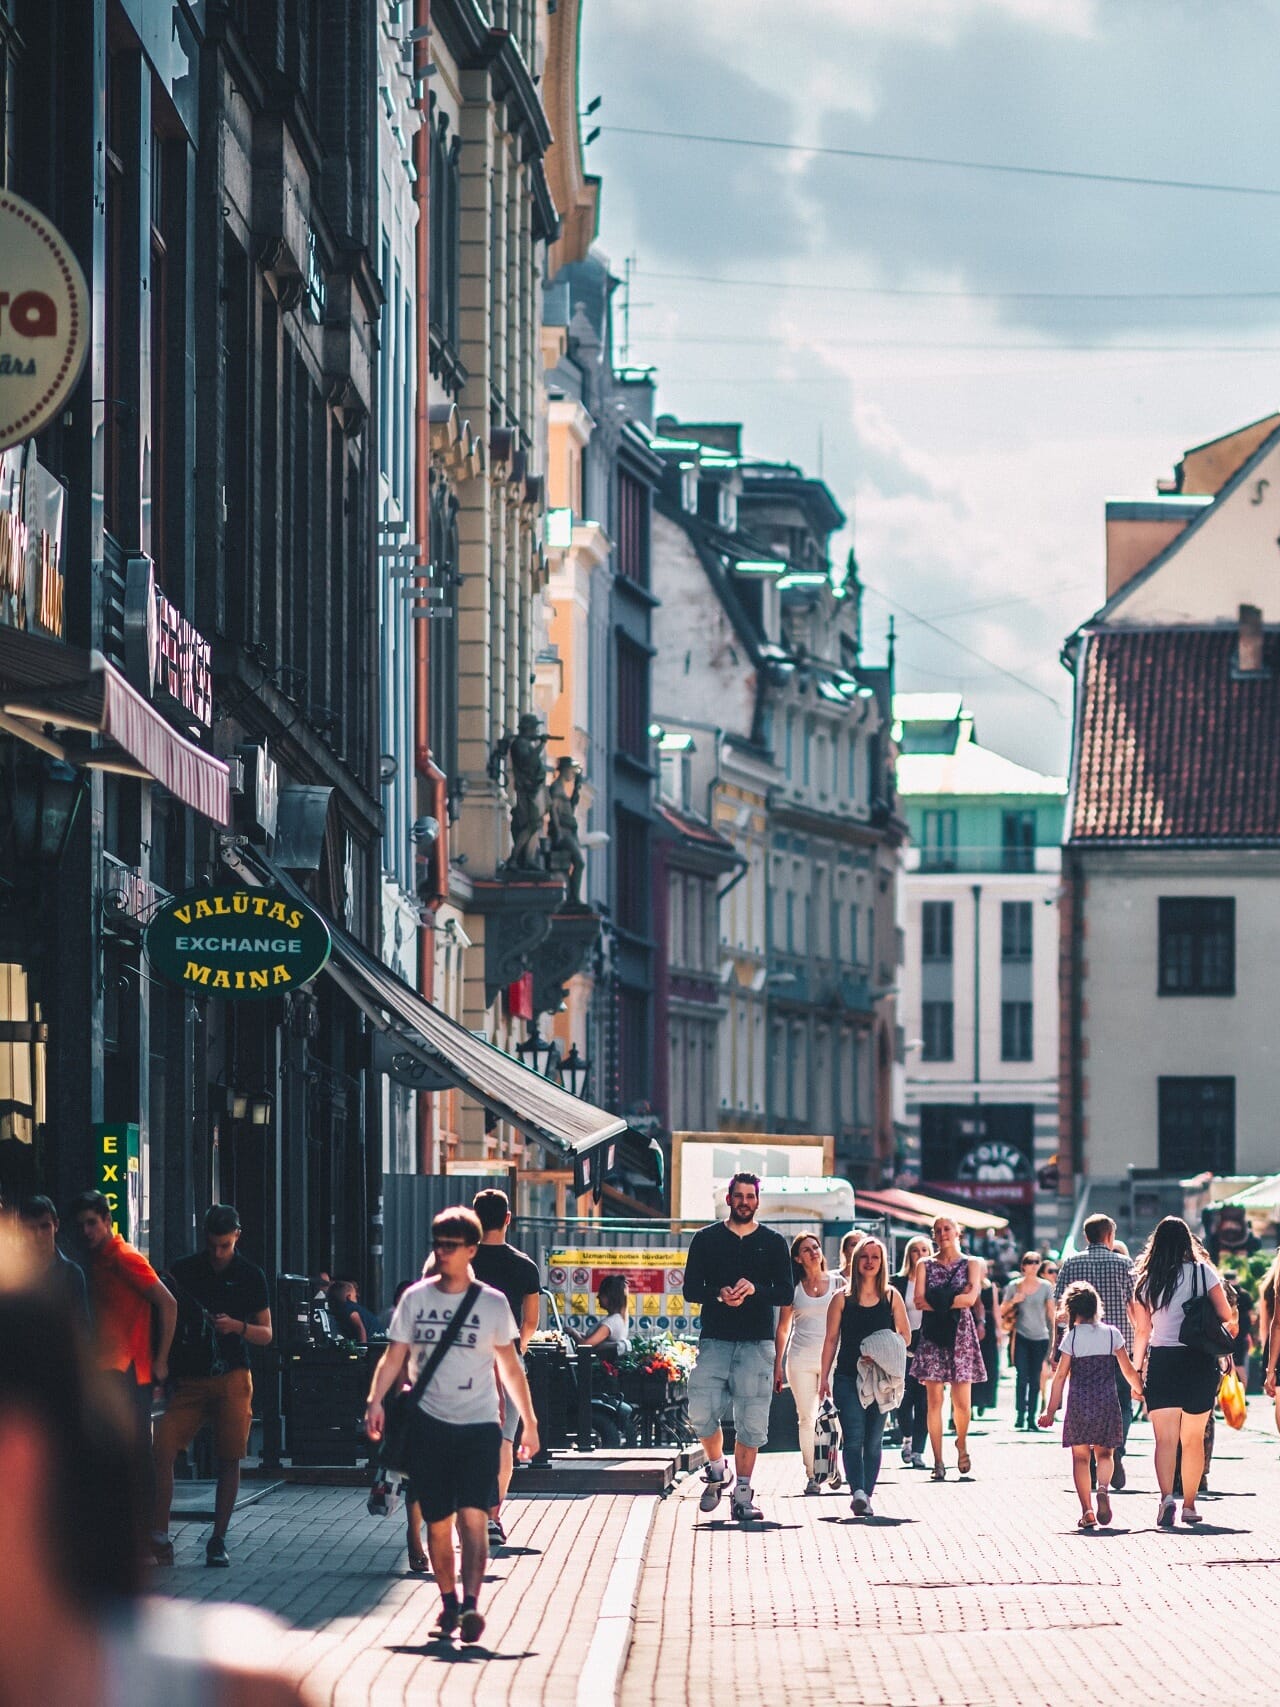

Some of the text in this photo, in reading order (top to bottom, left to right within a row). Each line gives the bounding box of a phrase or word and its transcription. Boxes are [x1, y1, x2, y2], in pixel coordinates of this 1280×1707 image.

[173, 891, 304, 929] VALŪTAS
[175, 936, 301, 953] EXCHANGE
[183, 961, 292, 991] MAIŅA
[416, 1309, 452, 1320] JAC
[415, 1328, 477, 1344] JOES
